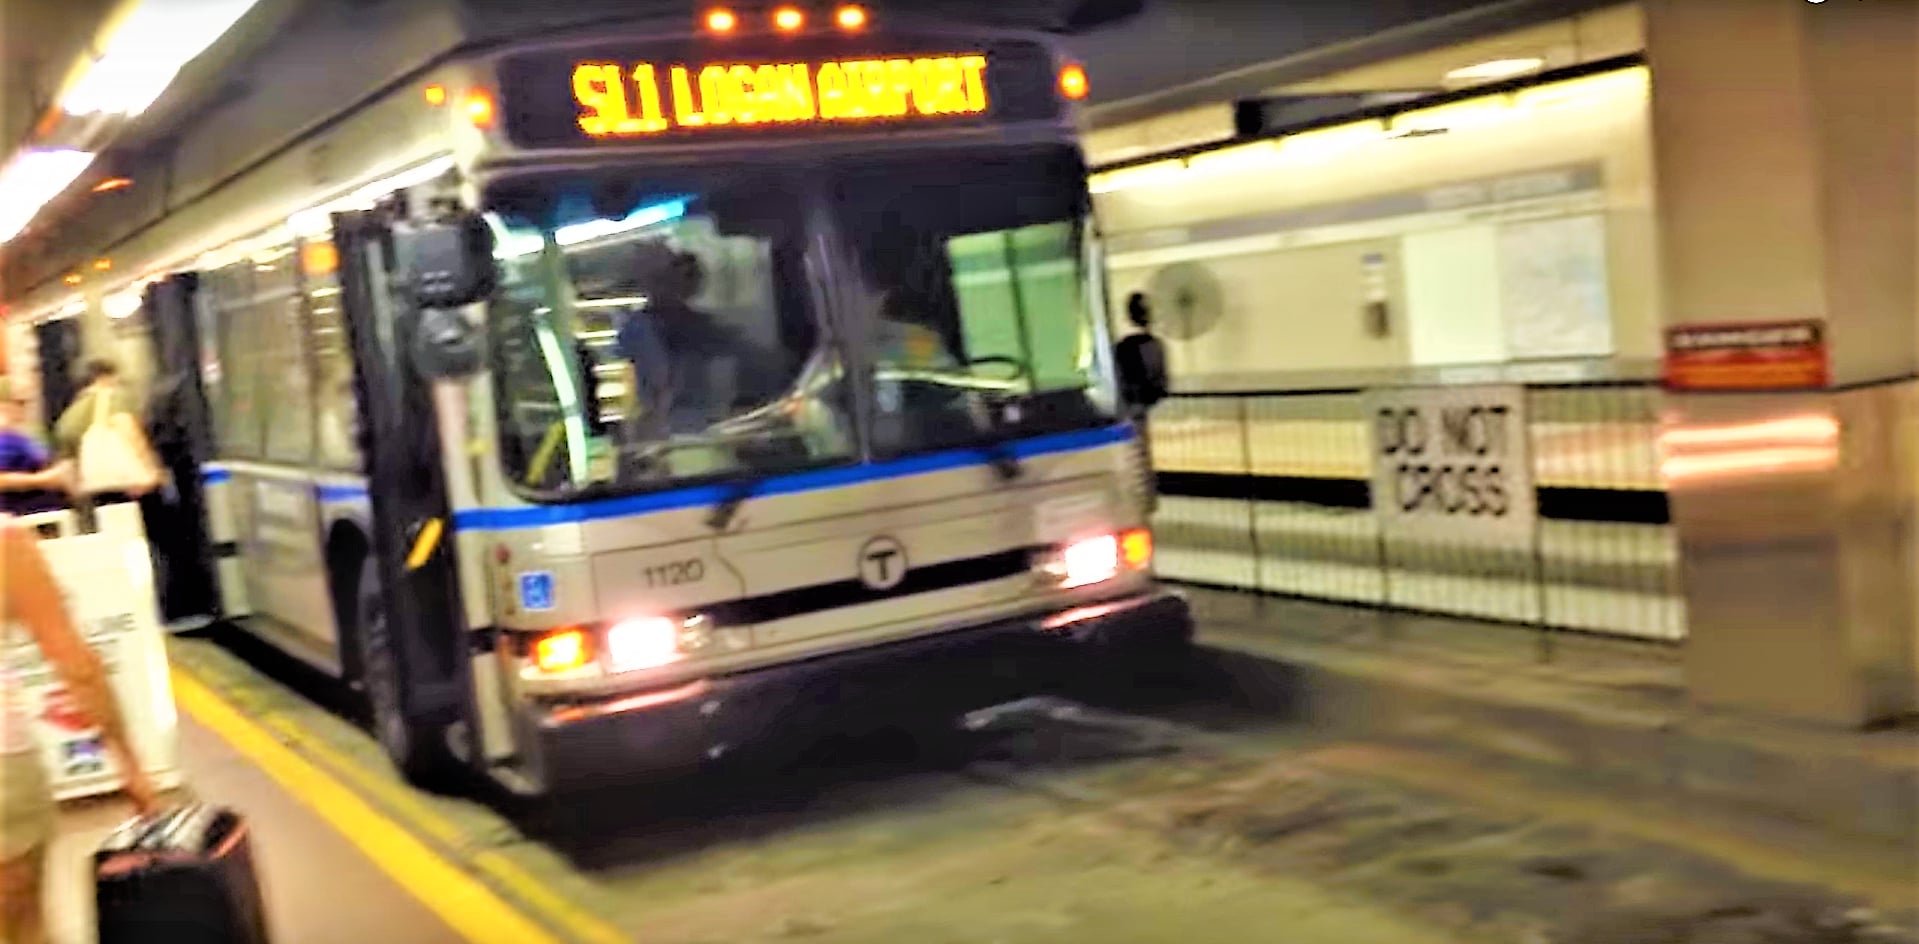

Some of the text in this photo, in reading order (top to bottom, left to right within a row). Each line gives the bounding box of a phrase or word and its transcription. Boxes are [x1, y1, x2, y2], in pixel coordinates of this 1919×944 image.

[573, 54, 988, 135] SL1 LOGAN AIRPORT
[1378, 404, 1509, 456] DO NOT
[1396, 463, 1508, 517] CROSS
[642, 557, 705, 588] 1120
[866, 549, 897, 581] T
